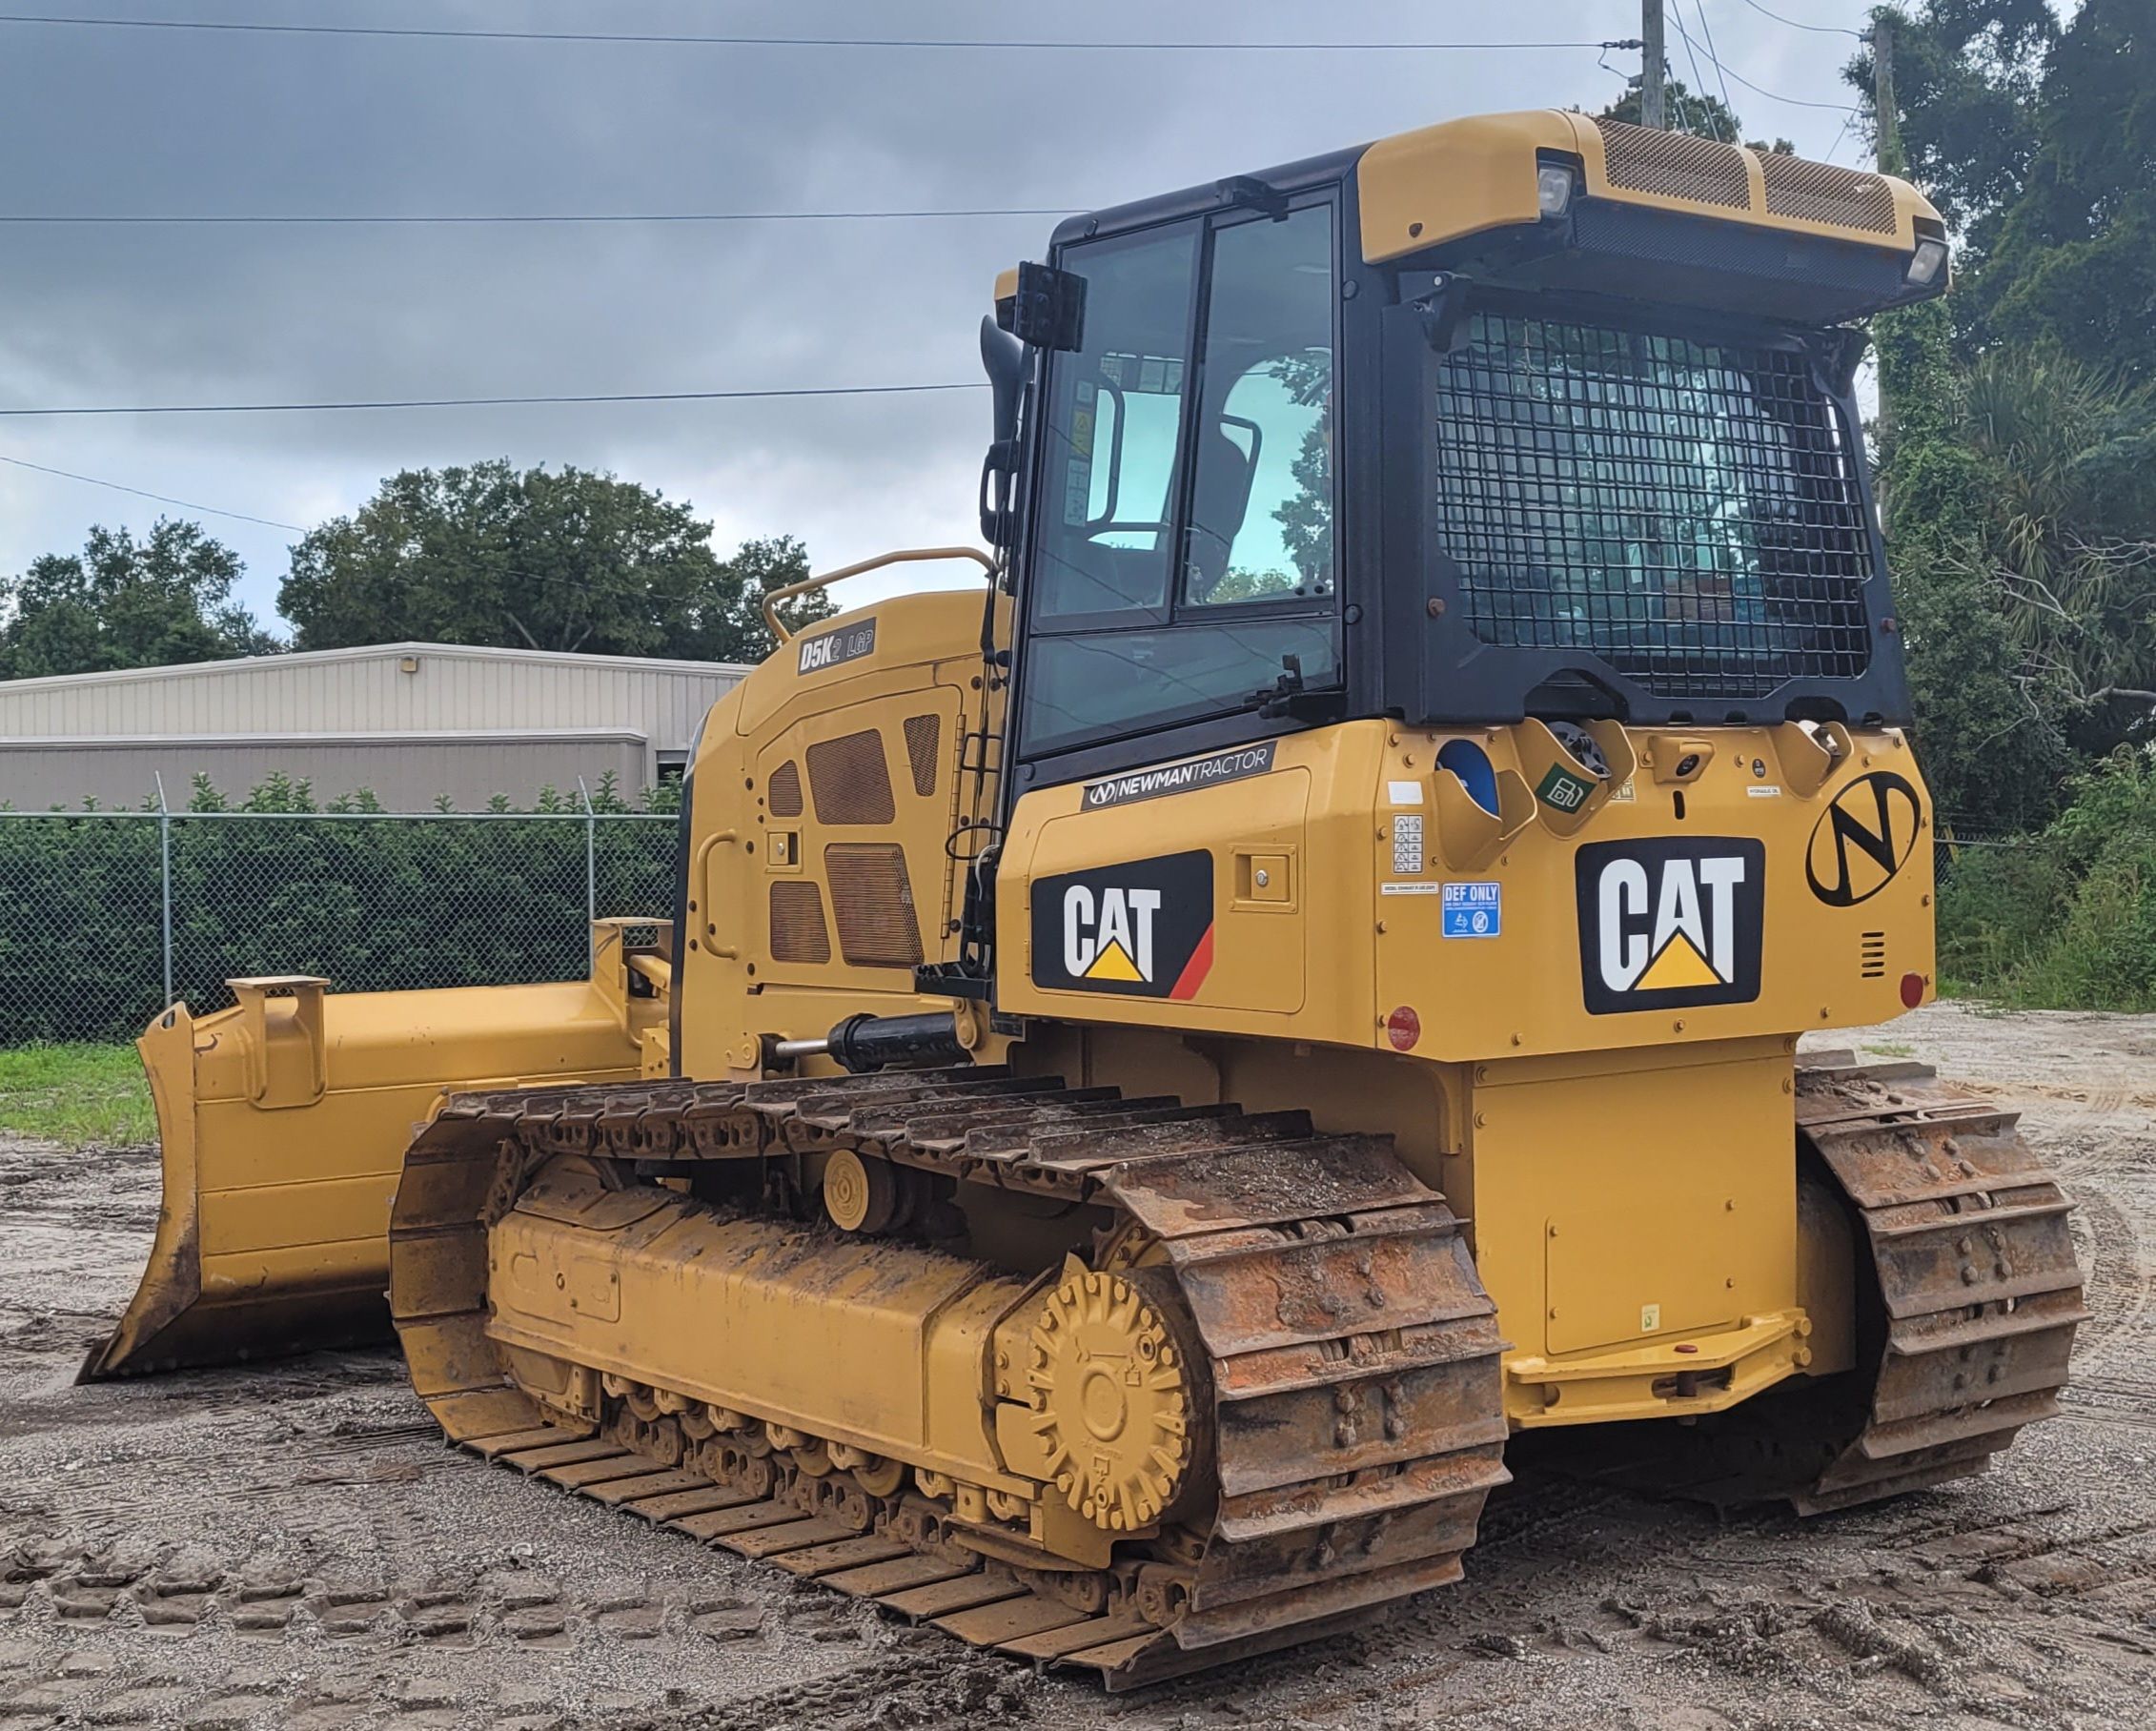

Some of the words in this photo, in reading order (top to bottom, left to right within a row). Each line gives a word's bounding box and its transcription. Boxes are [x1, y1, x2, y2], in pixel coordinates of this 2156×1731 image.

[846, 629, 874, 658] LGP
[1445, 886, 1467, 902] DEF
[1470, 885, 1497, 902] ONLY
[1598, 856, 1745, 991] CAT
[1064, 885, 1161, 983] CAT
